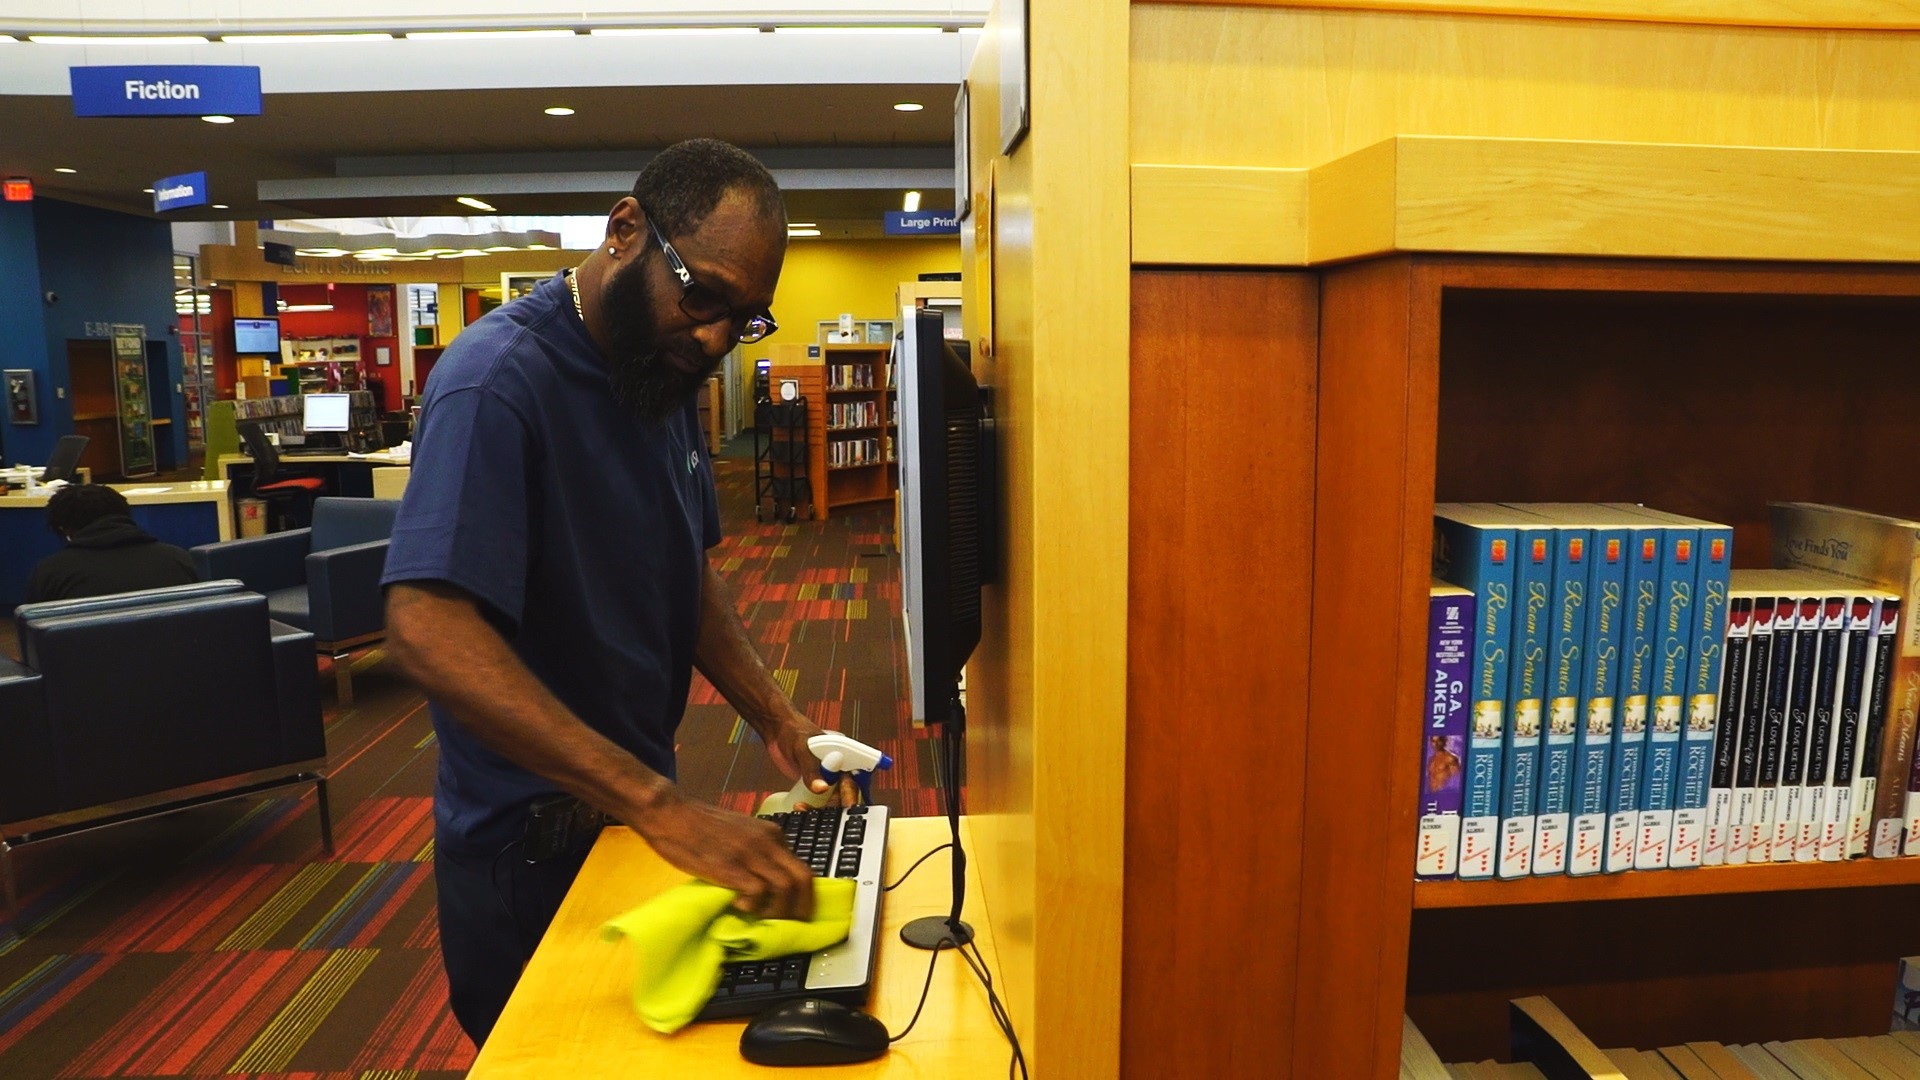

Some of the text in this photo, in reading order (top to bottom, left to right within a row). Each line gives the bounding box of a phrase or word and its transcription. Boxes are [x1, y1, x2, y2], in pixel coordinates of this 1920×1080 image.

[125, 80, 200, 100] Fiction
[900, 217, 958, 230] Large Print
[1804, 539, 1829, 557] Finds
[1828, 538, 1849, 561] You
[1486, 581, 1508, 636] Room
[1526, 581, 1546, 634] Room
[1562, 580, 1583, 633] Room
[1600, 581, 1620, 633] Room
[1636, 580, 1654, 632] Room
[1668, 580, 1690, 633] Room
[1703, 580, 1724, 632] Room
[1482, 640, 1505, 698] Service
[1523, 638, 1543, 696] Service
[1559, 637, 1579, 694] Service
[1595, 637, 1616, 694] Service
[1632, 636, 1650, 692] Service
[1663, 637, 1685, 692] Service
[1698, 635, 1719, 691] Service
[1432, 669, 1448, 728] AIKEN
[1448, 680, 1464, 716] G.A.
[1749, 715, 1757, 732] LOVE
[1767, 747, 1775, 762] LIKE
[1769, 726, 1777, 745] LOVE
[1791, 747, 1799, 762] LIKE
[1792, 726, 1801, 745] LOVE
[1815, 746, 1823, 761] LIKE
[1816, 725, 1824, 745] LOVE
[1842, 747, 1850, 762] LIKE
[1844, 726, 1852, 745] LOVE
[1897, 711, 1915, 761] Orleans
[1471, 754, 1488, 817] ROCHELL
[1512, 752, 1528, 815] ROCHELL
[1546, 750, 1563, 813] ROCHELL
[1583, 750, 1599, 813] ROCHELL
[1619, 748, 1634, 812] ROCHELL
[1649, 748, 1666, 809] ROCHELL
[1683, 746, 1701, 807] ROCHELL
